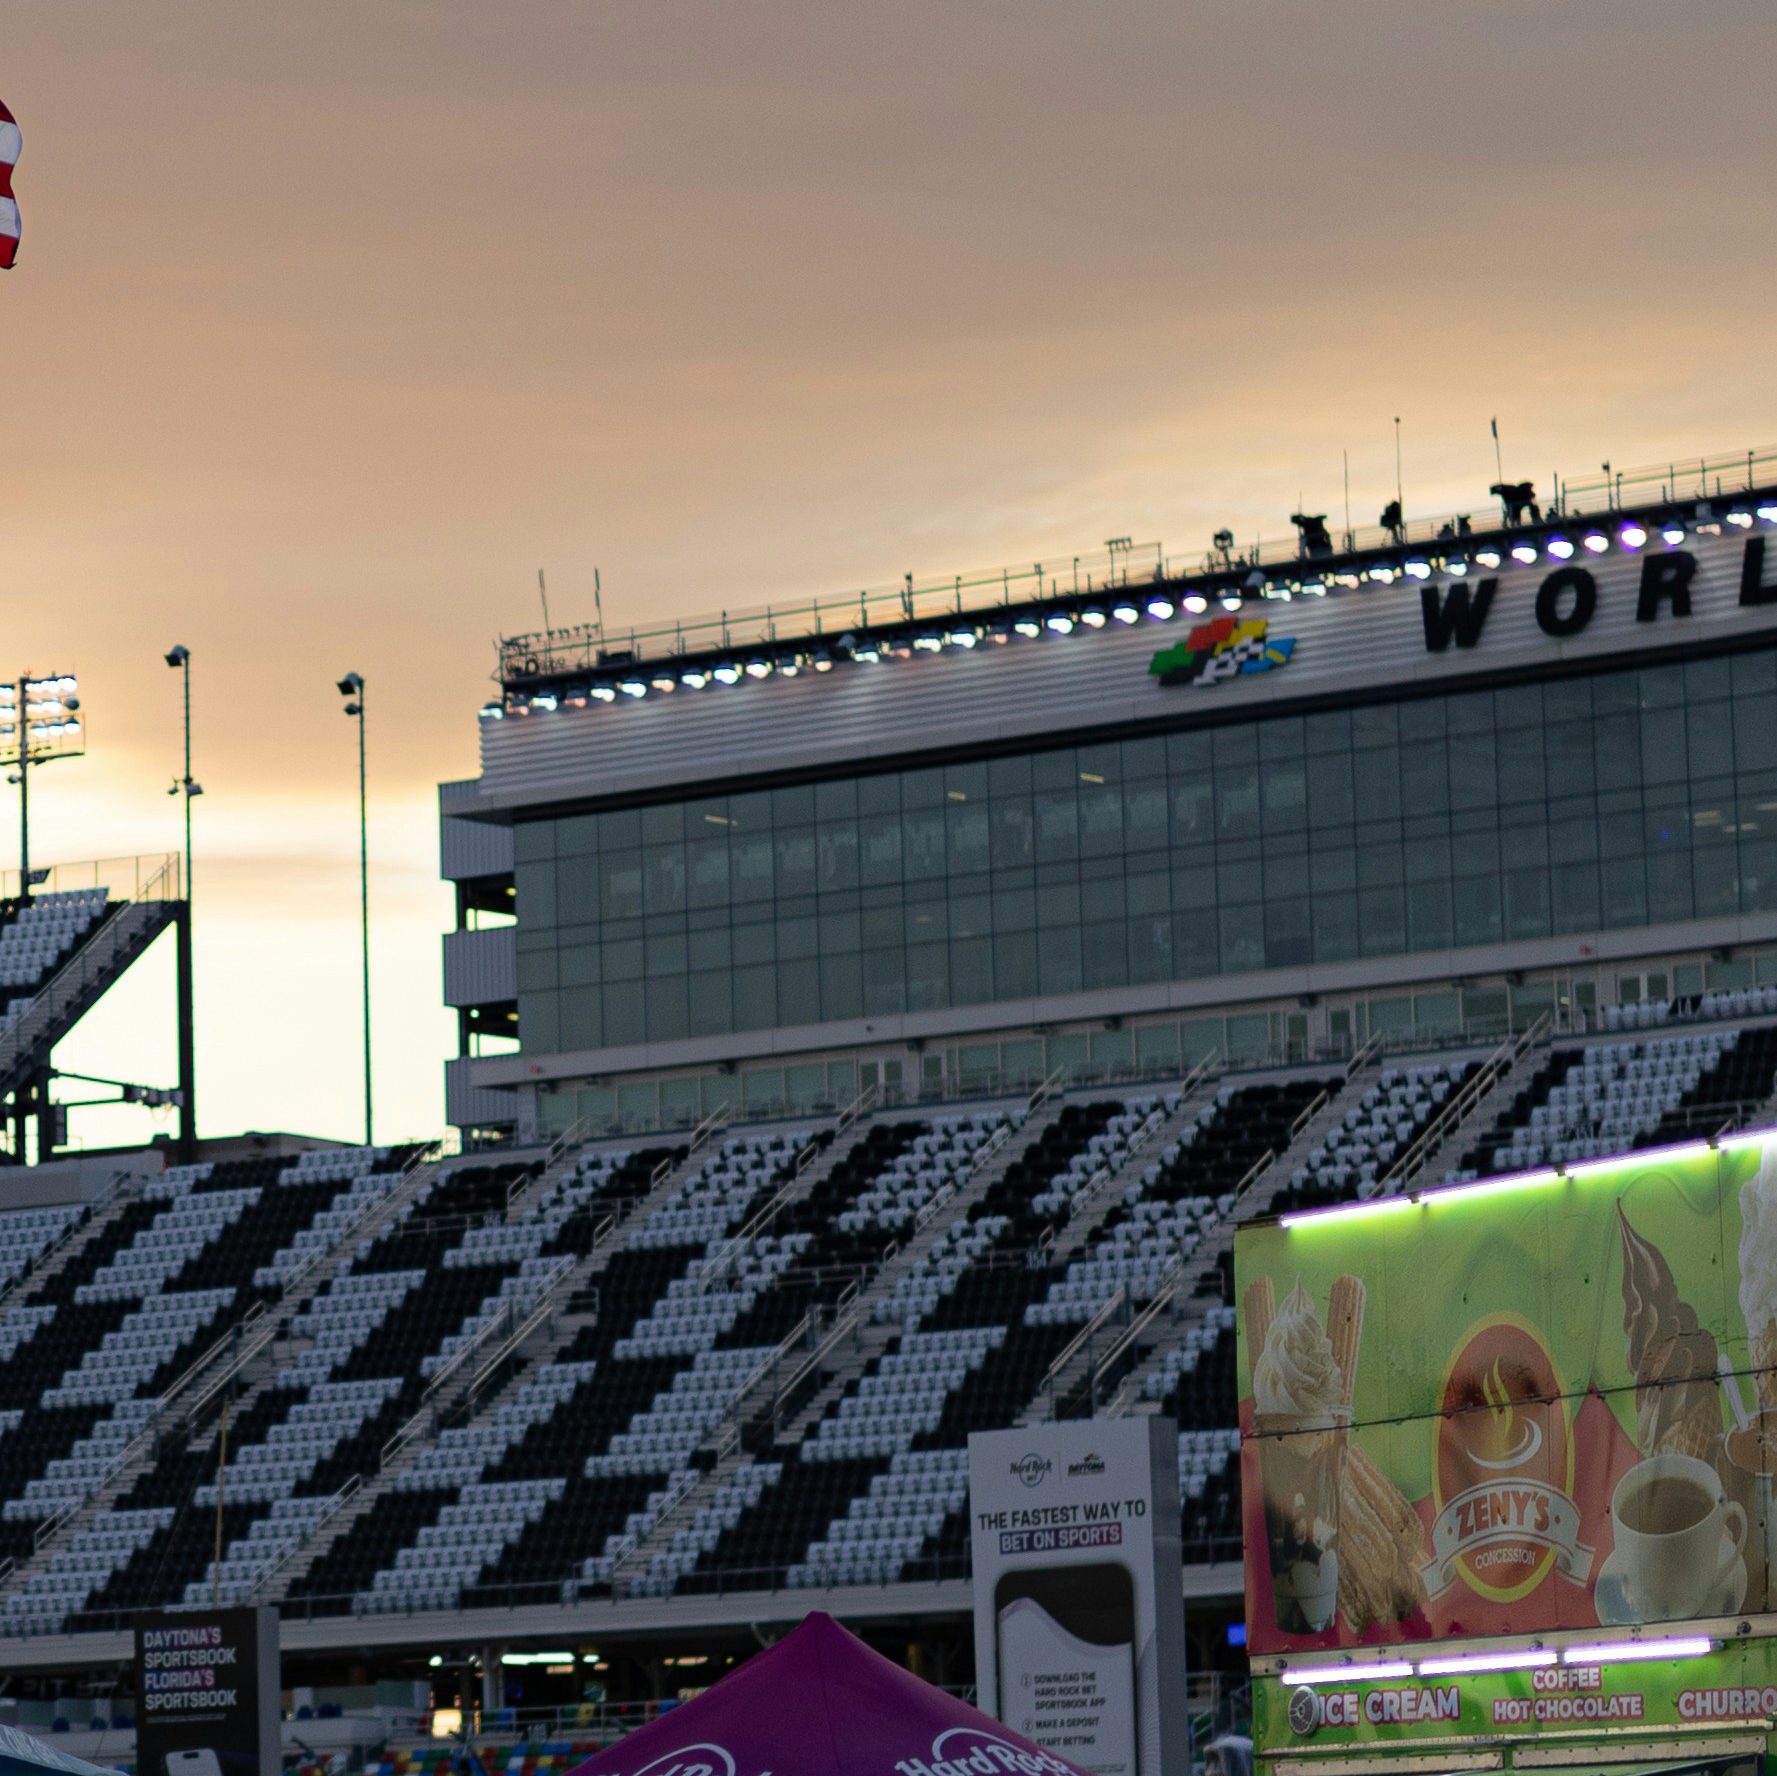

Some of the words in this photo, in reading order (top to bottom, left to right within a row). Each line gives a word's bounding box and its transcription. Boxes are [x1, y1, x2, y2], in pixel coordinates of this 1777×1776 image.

[979, 1512, 1007, 1531] THE
[1011, 1505, 1079, 1528] FASTEST
[1083, 1501, 1121, 1522] WAY
[1125, 1499, 1146, 1518] TO
[1456, 1490, 1550, 1542] ZENY'S
[1001, 1532, 1031, 1552] BET
[1033, 1530, 1055, 1550] ON
[1058, 1524, 1121, 1548] SPORTS
[1475, 1547, 1537, 1570] CONCESSION
[143, 1626, 222, 1649] DAYTONA'S
[144, 1647, 237, 1670] SPORTSBOOK
[144, 1669, 215, 1691] FLORIDA'S
[1034, 1672, 1081, 1684] DOWNLOAD
[1081, 1671, 1097, 1682] THE
[1533, 1667, 1600, 1689] COFFEE
[144, 1688, 238, 1711] SPORTSBOOK
[1058, 1685, 1081, 1697] ROCK
[1679, 1688, 1777, 1717] CHURRO
[1035, 1698, 1088, 1711] SPORTSBOOK
[1089, 1697, 1106, 1707] APP
[1320, 1693, 1359, 1724] ICE
[1365, 1686, 1461, 1722] CREAM
[1494, 1699, 1532, 1722] HOT
[1534, 1695, 1643, 1719] CHOCOLATE
[1036, 1719, 1057, 1729] MAKE
[1066, 1716, 1100, 1728] DEPOSIT
[1037, 1737, 1062, 1746] START
[1063, 1735, 1096, 1746] BETTING
